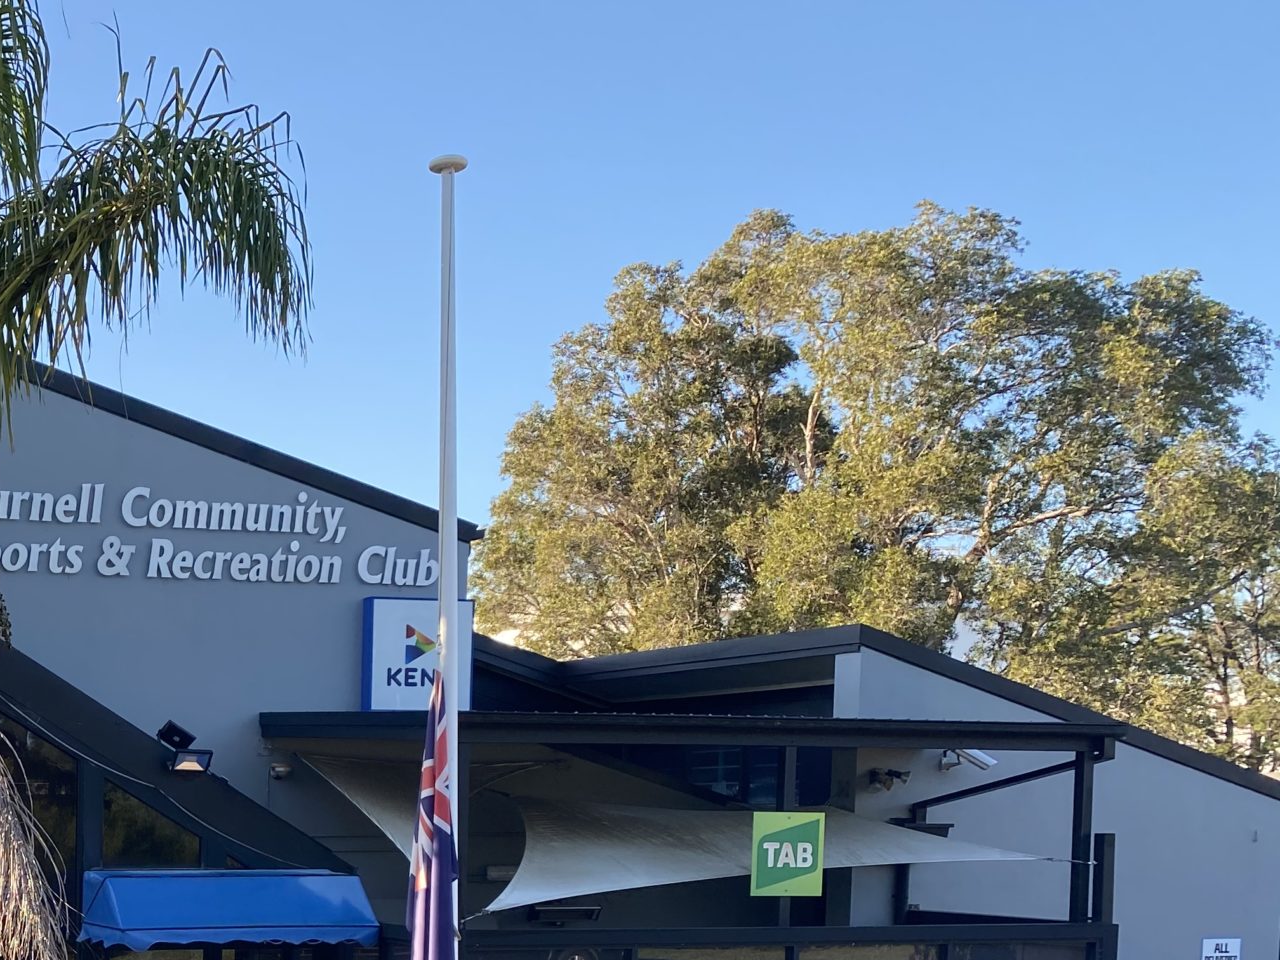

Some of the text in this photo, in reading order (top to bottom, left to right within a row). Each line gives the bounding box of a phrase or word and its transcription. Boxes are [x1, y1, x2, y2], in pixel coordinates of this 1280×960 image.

[121, 486, 347, 543] Community,
[97, 535, 136, 576] &
[147, 538, 343, 583] Recreation
[358, 545, 439, 586] Club
[387, 667, 437, 687] KEN
[763, 842, 813, 868] TAB
[1214, 943, 1230, 954] ALL
